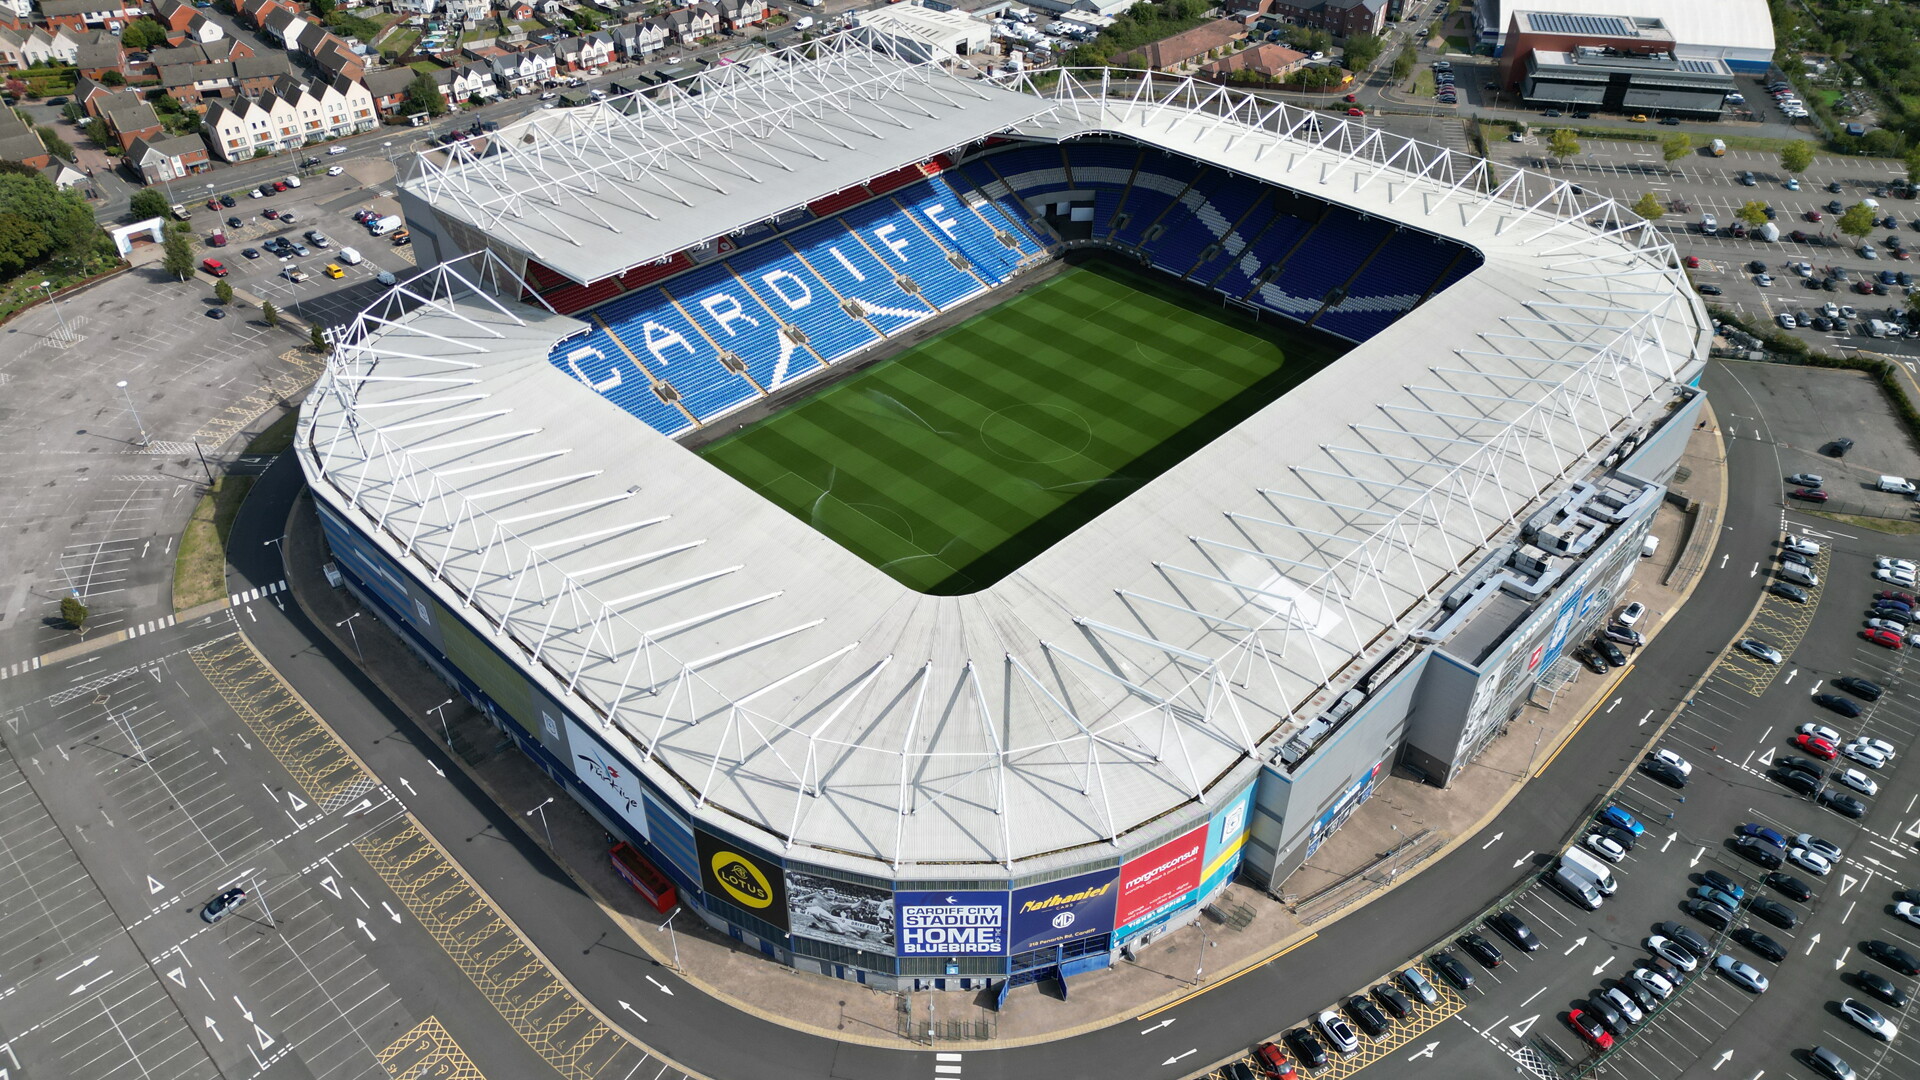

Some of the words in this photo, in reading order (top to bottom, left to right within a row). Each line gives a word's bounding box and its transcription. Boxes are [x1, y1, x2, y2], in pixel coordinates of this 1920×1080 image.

[567, 203, 958, 392] CARDIFF
[1125, 845, 1200, 890] morgansconsult
[721, 871, 765, 898] LOTUS
[1019, 883, 1111, 914] Nathaniel
[1519, 892, 1528, 900] P7
[906, 907, 964, 915] CARDIFF
[906, 915, 998, 926] STADIUM
[1054, 912, 1074, 928] MG
[903, 928, 994, 944] HOME
[1040, 936, 1064, 944] Penarth
[1075, 928, 1096, 936] Cardiff
[904, 943, 1001, 953] BLUEBIRDS
[1444, 945, 1455, 954] P2
[386, 1063, 398, 1074] 45
